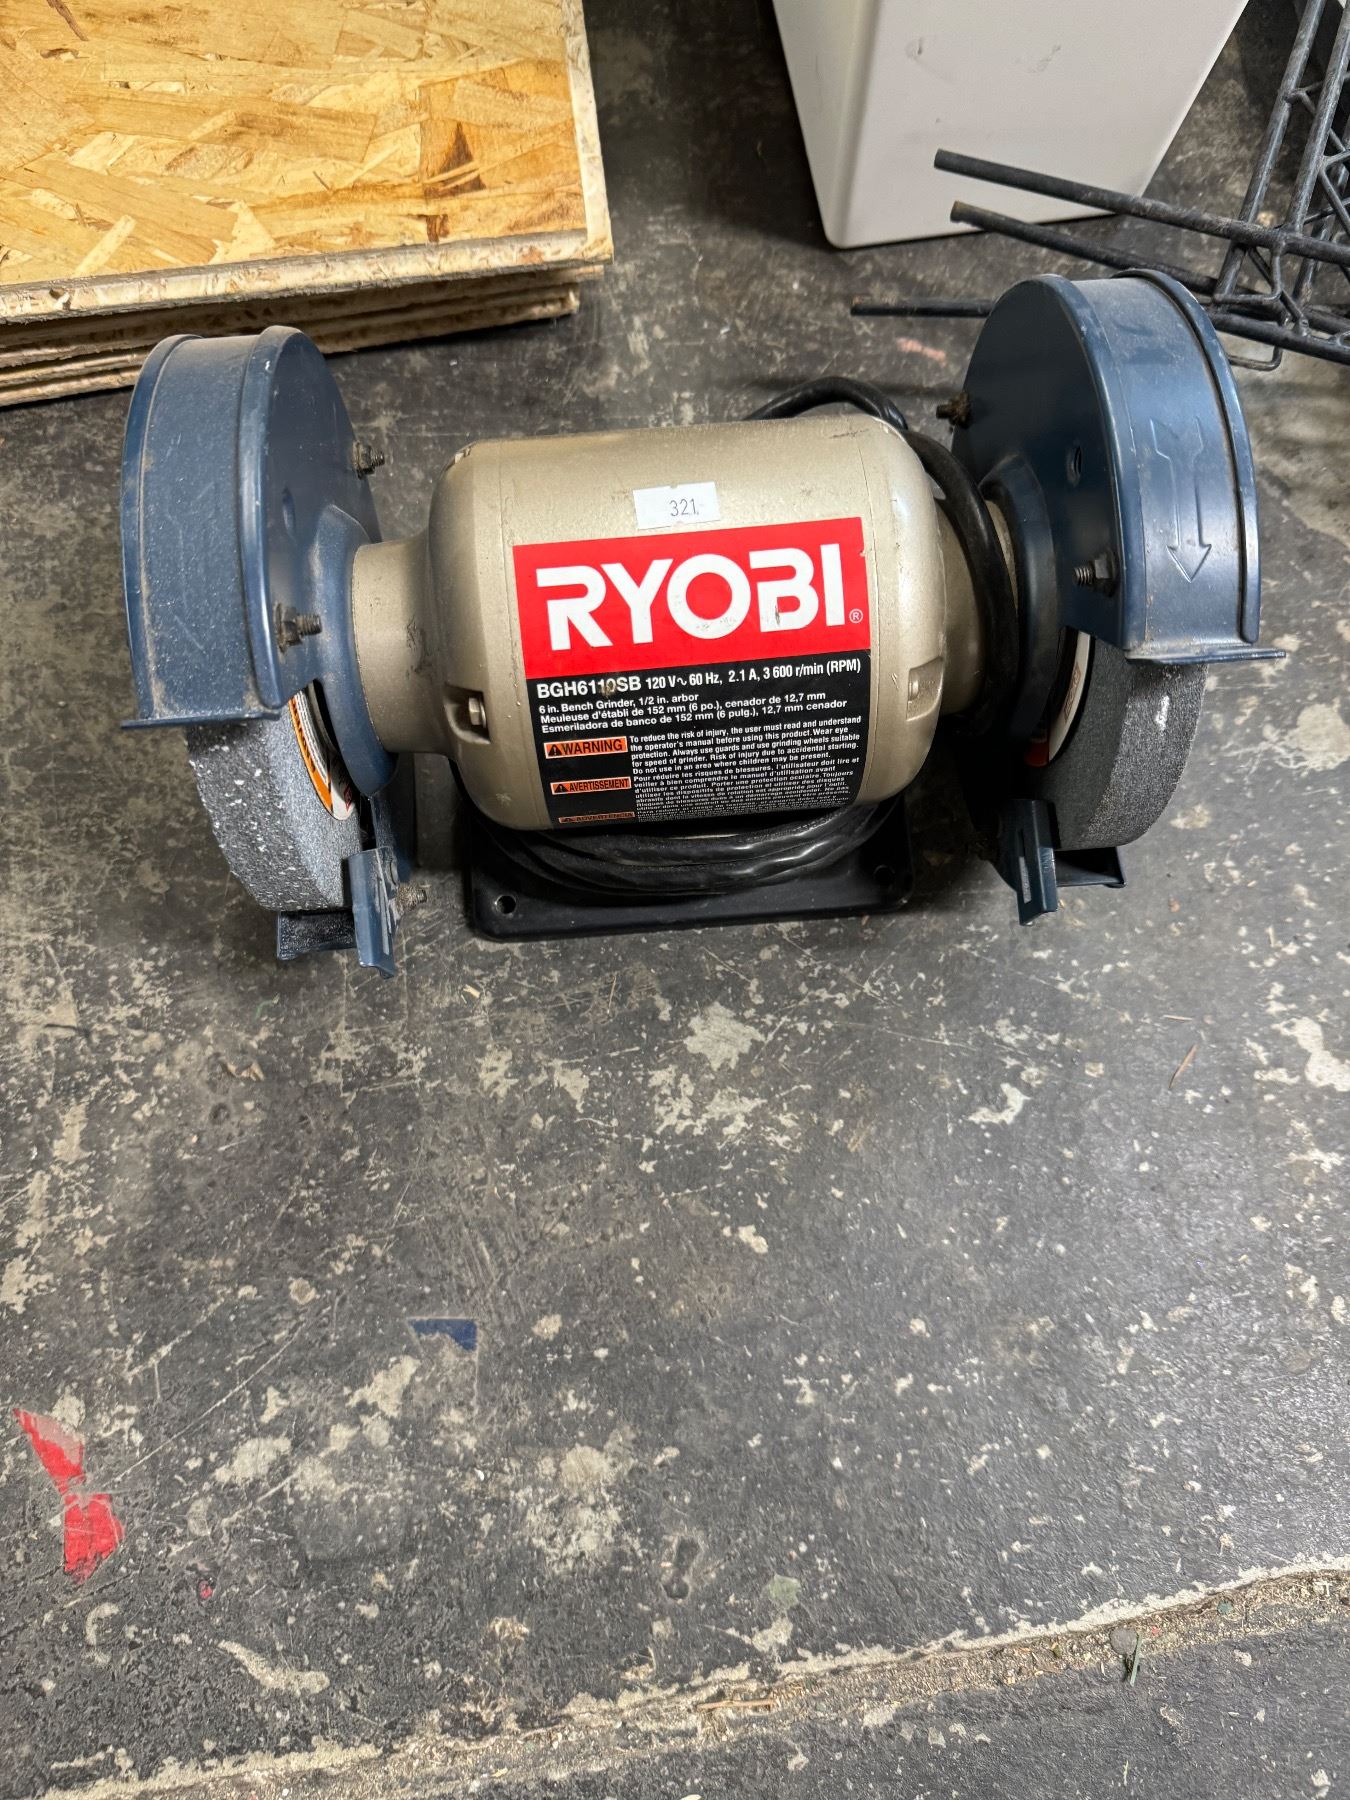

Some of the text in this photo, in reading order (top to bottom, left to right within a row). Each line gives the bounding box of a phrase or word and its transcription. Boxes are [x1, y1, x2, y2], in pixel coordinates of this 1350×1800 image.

[536, 543, 845, 650] RYOBI
[537, 676, 642, 698] BGH6110SB
[646, 676, 666, 689] 120
[688, 673, 703, 685] 60
[705, 671, 723, 687] Hz,
[728, 669, 745, 682] 2.1
[748, 668, 761, 683] A,
[762, 667, 771, 679] 3
[772, 665, 793, 678] 600
[795, 662, 824, 676] r/min
[826, 659, 862, 676] (RPM)
[540, 712, 590, 723] Meuleuse
[591, 709, 629, 719] d'établi
[631, 707, 644, 716] de
[647, 706, 665, 714] 152
[688, 703, 698, 712] (6
[700, 701, 723, 712] po.),
[724, 697, 766, 708] cenador
[768, 696, 781, 704] de
[784, 694, 804, 704] 12,7
[547, 704, 559, 713] in.
[561, 702, 594, 712] Bench
[595, 698, 636, 710] Grinder,
[639, 697, 654, 705] 1/2
[656, 696, 669, 704] in.
[671, 693, 699, 703] arbor
[542, 720, 608, 733] Esmeriladora
[610, 719, 624, 727] de
[625, 716, 657, 726] banco
[659, 715, 672, 723] de
[675, 713, 693, 722] 152
[716, 710, 726, 720] (6
[728, 707, 759, 719] pulg.),
[762, 705, 782, 716] 12,7
[806, 699, 848, 710] cenador
[629, 735, 639, 743] To
[640, 733, 666, 742] reduce
[731, 726, 743, 734] the
[763, 723, 782, 731] must
[783, 722, 801, 730] read
[802, 720, 817, 728] and
[818, 716, 862, 726] understand
[644, 740, 684, 751] operator's
[685, 738, 714, 746] manual
[716, 735, 741, 744] before
[742, 733, 763, 743] using
[834, 727, 849, 735] eye
[561, 739, 623, 755] WARNING
[631, 750, 671, 760] protection.
[672, 747, 698, 757] Always
[714, 744, 740, 753] guards
[741, 742, 756, 750] and
[771, 738, 802, 748] grinding
[803, 736, 829, 744] wheels
[830, 734, 860, 742] suitable
[644, 758, 667, 767] speed
[678, 755, 708, 764] grinder.
[738, 750, 760, 759] injury
[786, 744, 826, 754] accidental
[828, 742, 859, 752] starting.
[738, 757, 770, 765] children
[800, 752, 831, 761] present.
[569, 778, 629, 792] AVERTISSEMENT
